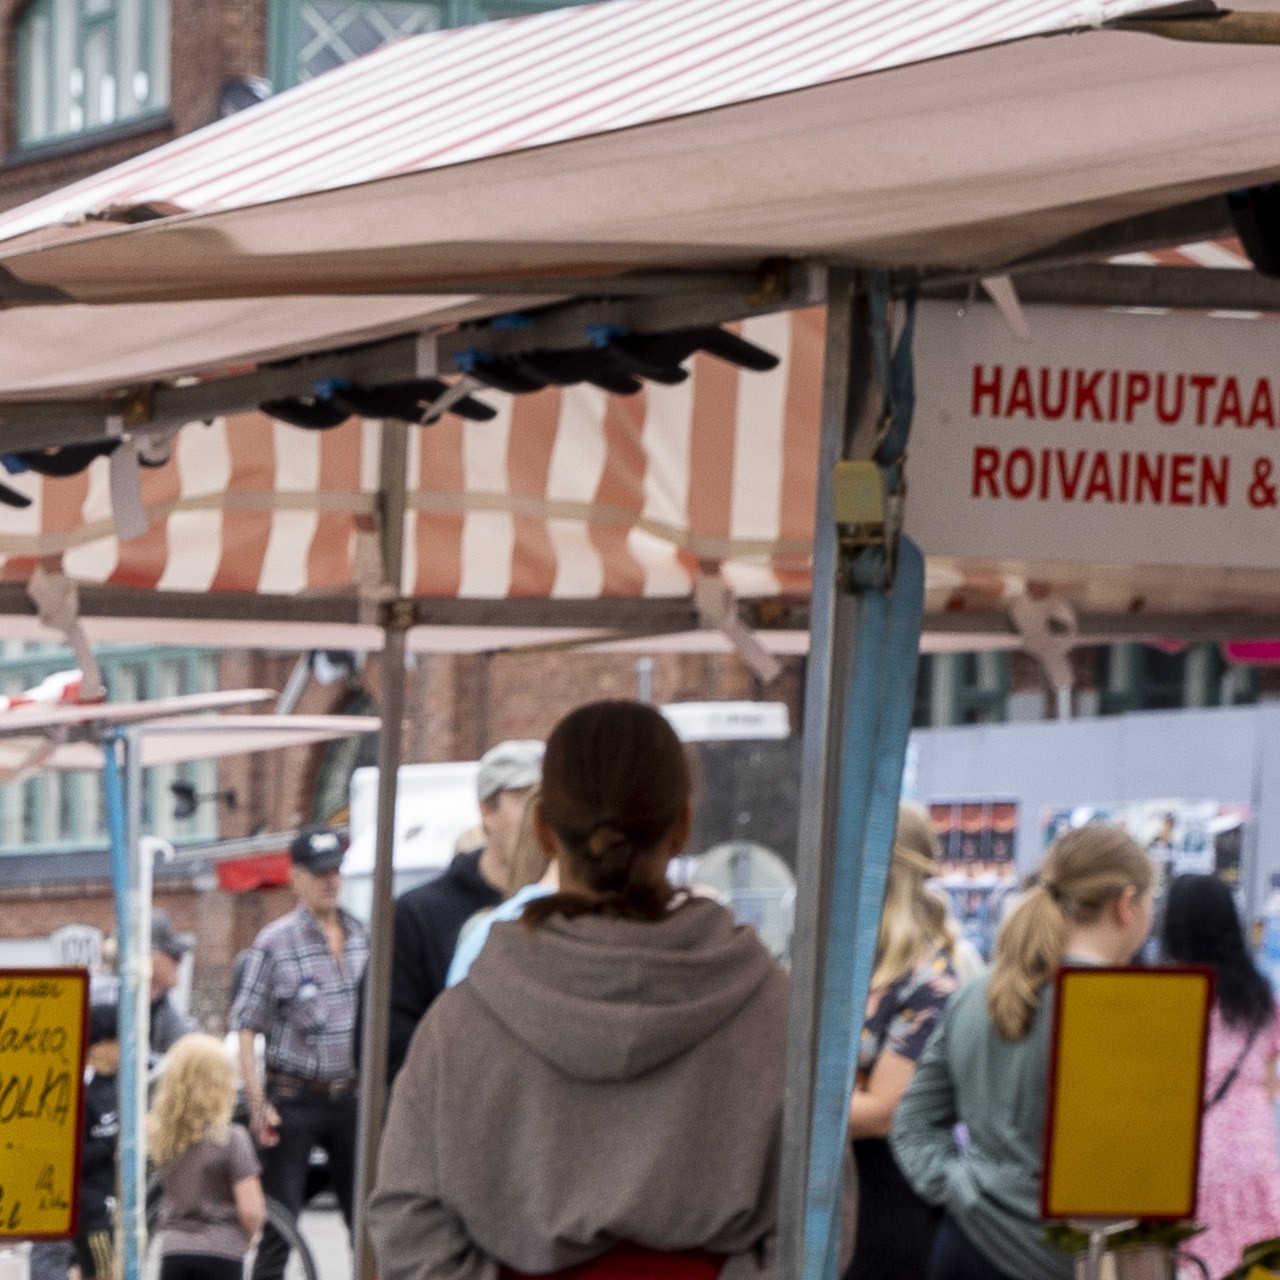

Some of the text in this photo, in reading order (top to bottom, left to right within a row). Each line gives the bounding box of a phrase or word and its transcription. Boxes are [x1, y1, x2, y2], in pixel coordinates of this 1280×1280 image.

[969, 363, 1280, 431] HAUKIPUTAA
[969, 446, 1278, 510] ROIVAINEN &
